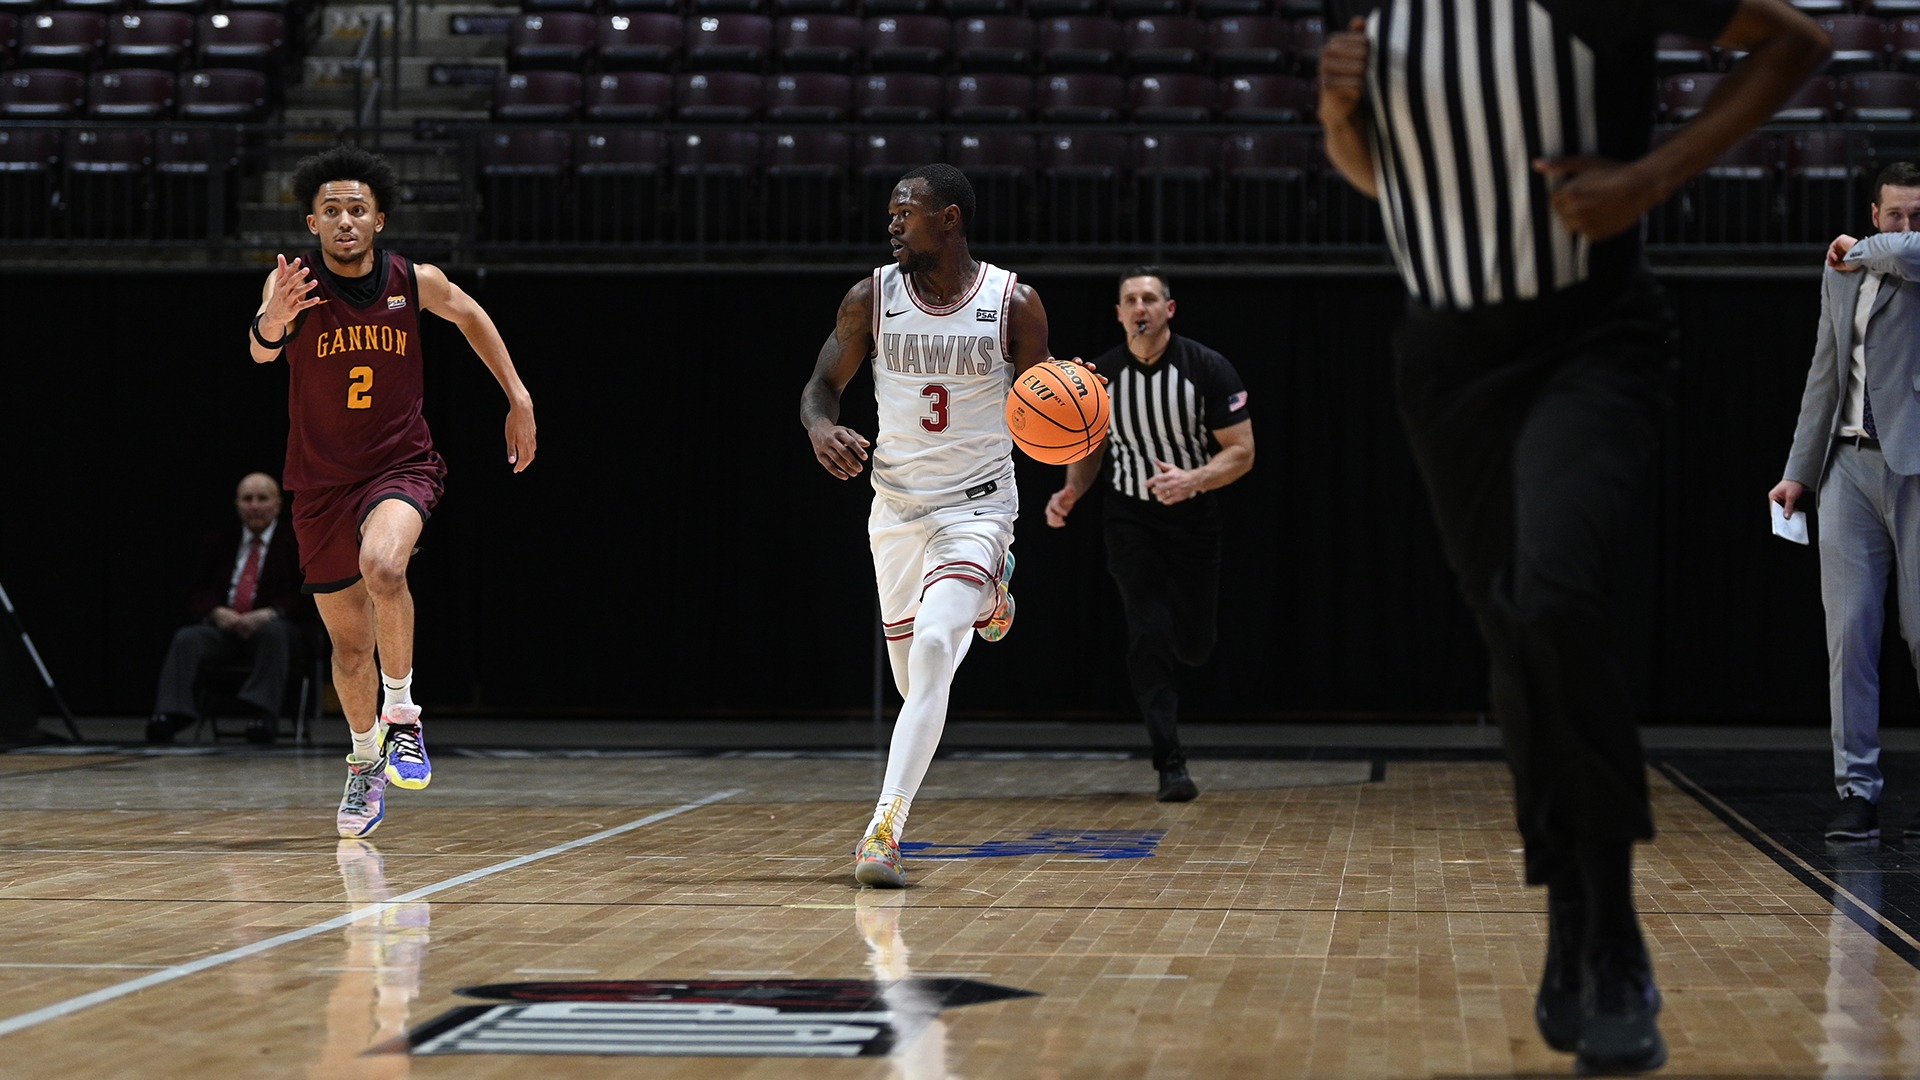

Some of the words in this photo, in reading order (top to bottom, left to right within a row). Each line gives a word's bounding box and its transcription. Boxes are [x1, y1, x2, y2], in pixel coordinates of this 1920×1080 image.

[317, 325, 407, 358] GANNON
[883, 333, 994, 376] HAWKS
[347, 365, 374, 409] 2
[919, 382, 951, 434] 3
[1022, 375, 1056, 401] EVO
